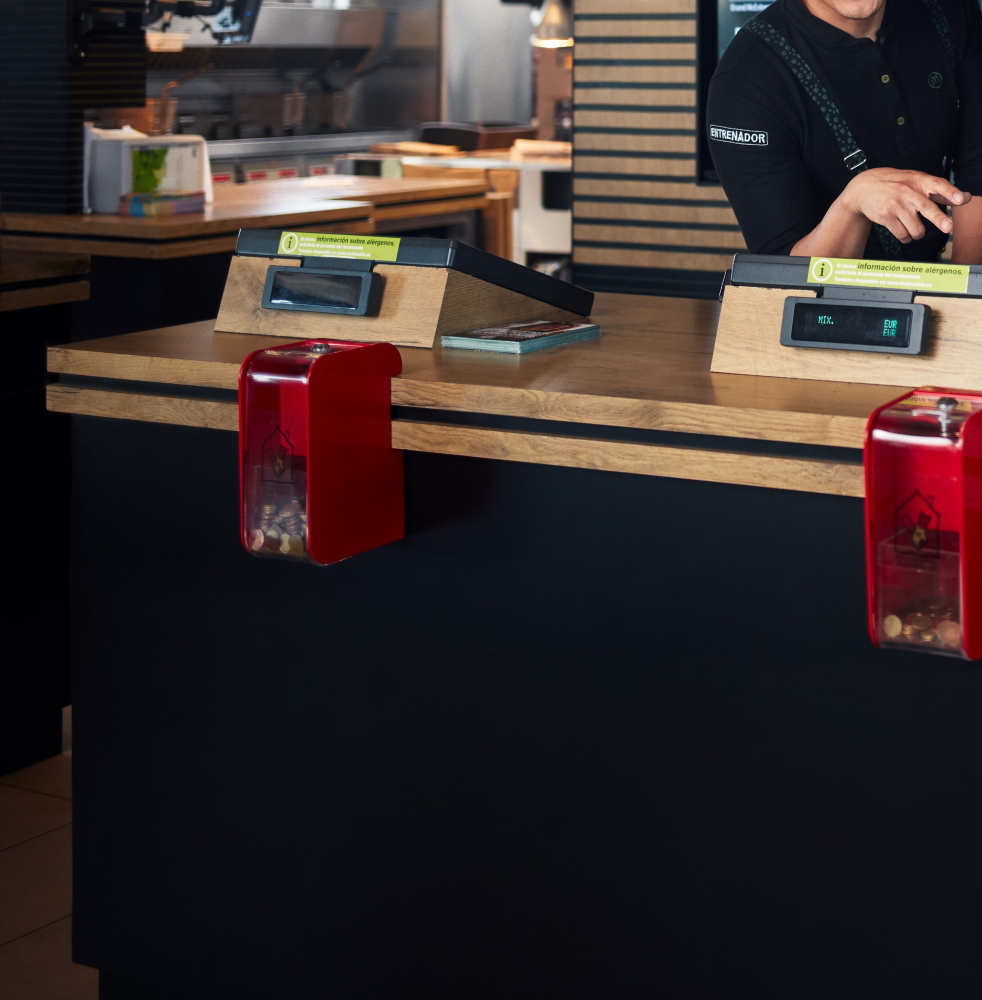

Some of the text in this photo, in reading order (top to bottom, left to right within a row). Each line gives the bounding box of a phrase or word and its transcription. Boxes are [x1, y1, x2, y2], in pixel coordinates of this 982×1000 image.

[710, 127, 766, 144] ENTRENADOR
[316, 235, 349, 244] información
[857, 262, 901, 272] información
[902, 265, 923, 273] sobre
[924, 265, 963, 276] alérgenos.
[883, 319, 898, 329] EUR
[882, 328, 896, 337] EUR
